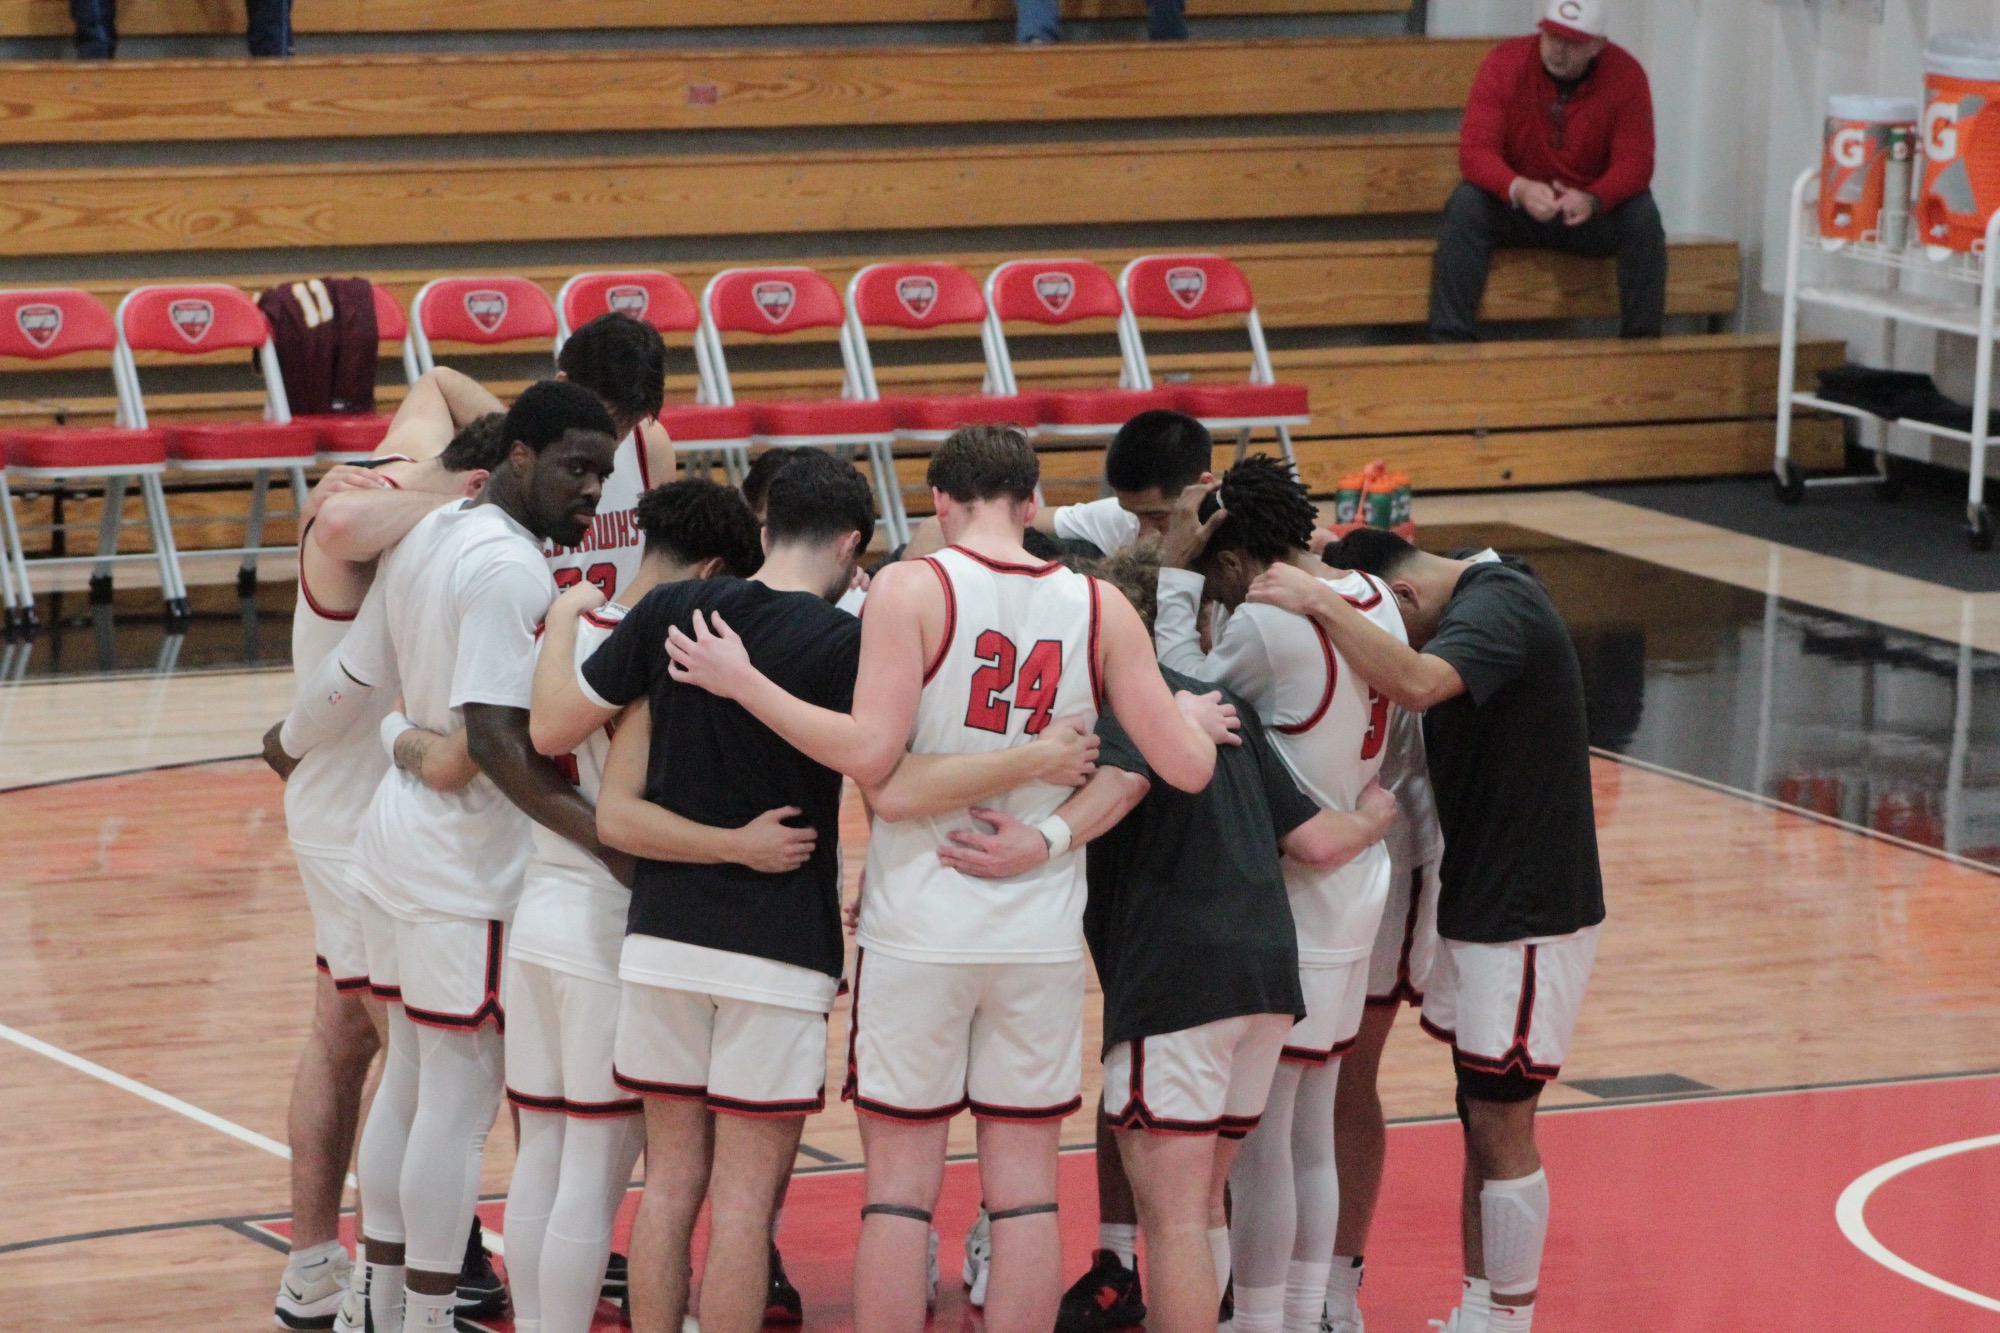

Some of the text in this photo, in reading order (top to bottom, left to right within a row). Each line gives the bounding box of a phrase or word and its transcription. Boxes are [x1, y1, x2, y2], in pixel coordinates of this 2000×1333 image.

[1558, 1, 1581, 20] C
[1833, 129, 1865, 168] G
[1925, 102, 1958, 161] G
[964, 629, 1063, 735] 24
